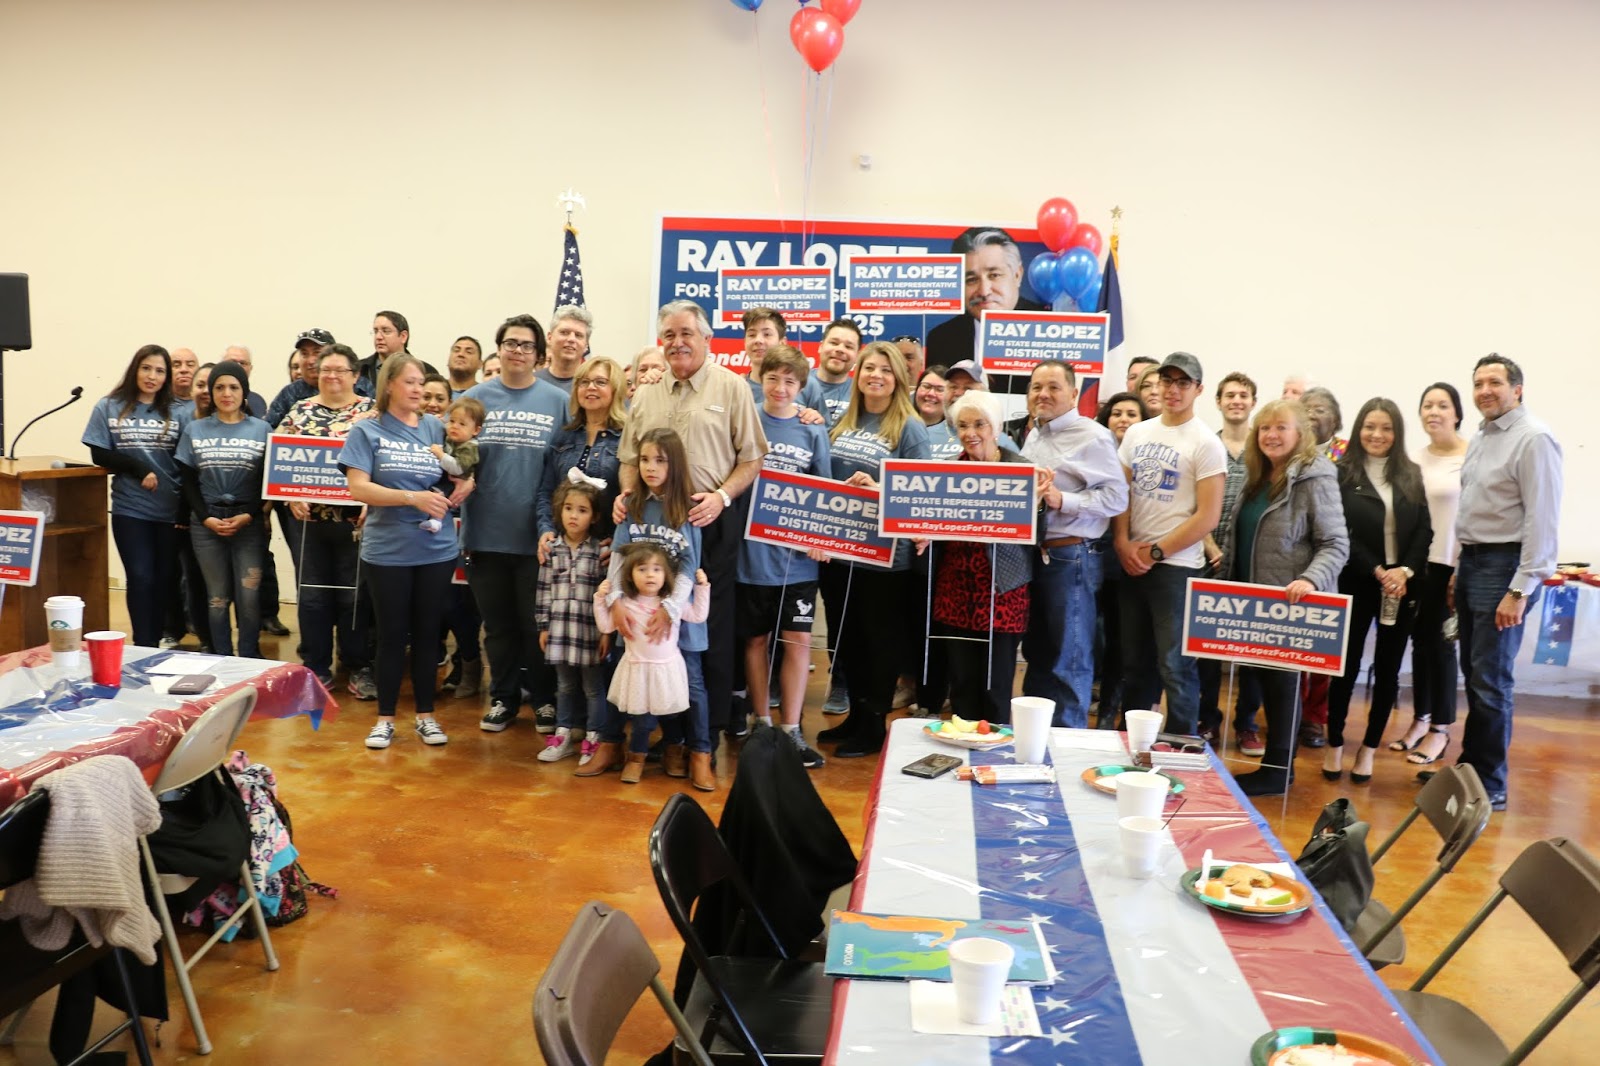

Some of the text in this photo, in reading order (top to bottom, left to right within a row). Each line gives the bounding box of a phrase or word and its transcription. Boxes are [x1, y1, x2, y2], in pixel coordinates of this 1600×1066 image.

[677, 238, 768, 272] RAY
[855, 265, 958, 279] RAY LOPEZ
[674, 282, 711, 298] FOR
[727, 278, 764, 291] RAY
[767, 277, 827, 291] LOPEZ
[870, 289, 941, 298] DISTRICT 125
[741, 301, 811, 310] DISTRICT 125
[860, 300, 951, 308] www.RayLopezForTX.com
[989, 322, 1101, 340] RAY LOPEZ
[1031, 341, 1100, 350] REPRESENTATIVE
[1005, 348, 1081, 360] DISTRICT 125
[107, 416, 136, 428] RAY
[485, 410, 554, 426] AY LOPEZ
[485, 427, 540, 437] DISTRICT 125
[192, 437, 266, 451] RAY LOPEZ
[379, 436, 410, 451] RAY
[862, 446, 878, 455] 125
[276, 446, 321, 463] RAY
[390, 455, 433, 464] DISTRICT
[1135, 442, 1180, 469] NATALIA
[273, 464, 292, 472] FOR
[293, 465, 320, 474] STATE
[291, 474, 349, 486] DISTRICT
[891, 475, 1028, 496] RAY LOPEZ
[763, 482, 879, 520] RAY LOPE
[890, 496, 1027, 509] FOR STATE REPRESENTATIVE
[760, 502, 780, 513] FOR
[780, 506, 810, 518] STATE
[910, 506, 1004, 521] DISTRICT 125
[629, 523, 648, 535] AY
[777, 515, 868, 542] DISTRICT 125
[897, 521, 1017, 534] www.RayLopezForTX.com
[763, 527, 877, 556] www.RayLopezForTX.com
[1197, 594, 1341, 628] RAY LOPEZ
[1195, 615, 1338, 640] FOR STATE REPRESENTATIVE
[1216, 628, 1314, 650] DISTRICT 125
[1202, 641, 1326, 664] www.RayLopezForTX.com
